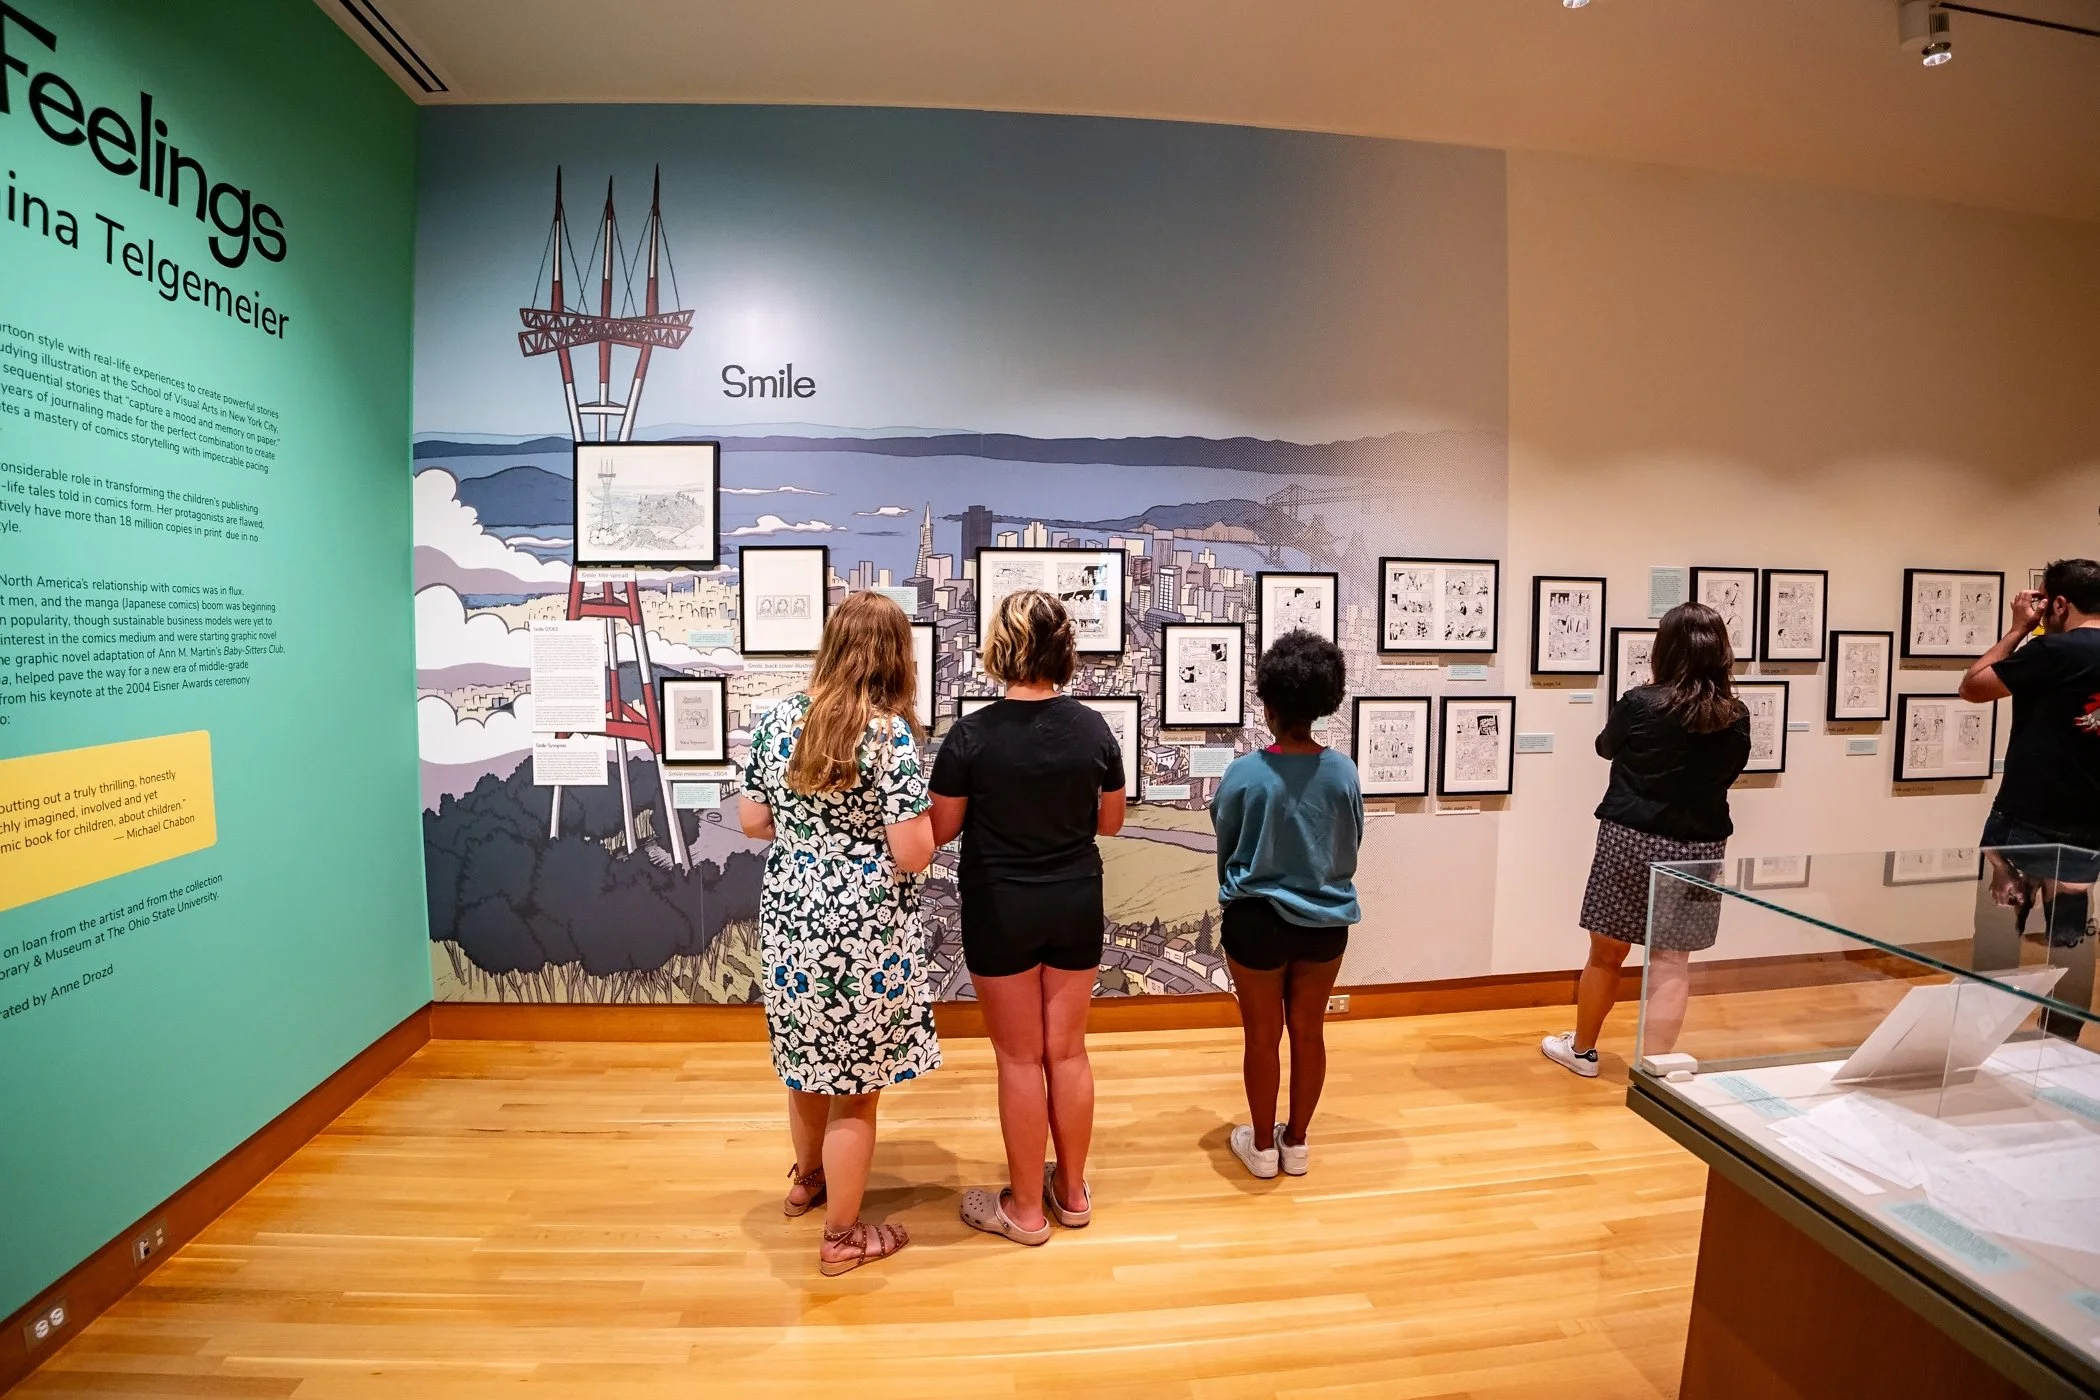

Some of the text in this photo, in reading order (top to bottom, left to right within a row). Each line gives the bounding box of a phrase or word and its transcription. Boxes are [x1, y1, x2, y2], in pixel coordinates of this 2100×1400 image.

[0, 2, 287, 268] Feelings
[95, 212, 289, 339] Telgemeier
[38, 335, 279, 419] style with real-life experiences create powerful stories
[41, 352, 262, 428] illustration the School Visual Arts York
[721, 362, 816, 399] Smile
[3, 363, 244, 438] sequential stories that mood memory
[1, 382, 276, 460] years journaling made perfect combination create
[34, 410, 269, 474] mastery comics storytelling with impeccable pacing
[28, 484, 224, 523] tales told comics form. Her protagonists
[71, 474, 259, 515] role transforming children's publishing
[34, 504, 193, 534] have more than million copies
[37, 576, 200, 594] America's relationship with comics
[9, 596, 276, 613] men, and the manga (Japanese comics) boom beginning
[11, 614, 251, 628] popularity, though sustainable business models were
[0, 630, 277, 645] interest the comics medium and were starting graphic novel
[15, 645, 267, 668] graphic novel adaptation Ann Martin's Baby-Sitters
[15, 660, 249, 685] helped pave the way middle-grade
[30, 676, 251, 702] his keynote the 2004 Eisner Awards ceremony
[43, 769, 176, 805] out truly thrilling, honestly
[24, 790, 158, 828] imagined, involved and yet
[126, 814, 195, 840] Michael Chabon
[25, 811, 145, 848] book for children, about
[4, 873, 223, 959] on loan from the artist and from the collection
[45, 890, 220, 963] Museum at The Ohio State University.
[33, 963, 114, 1007] by Anne Drozd
